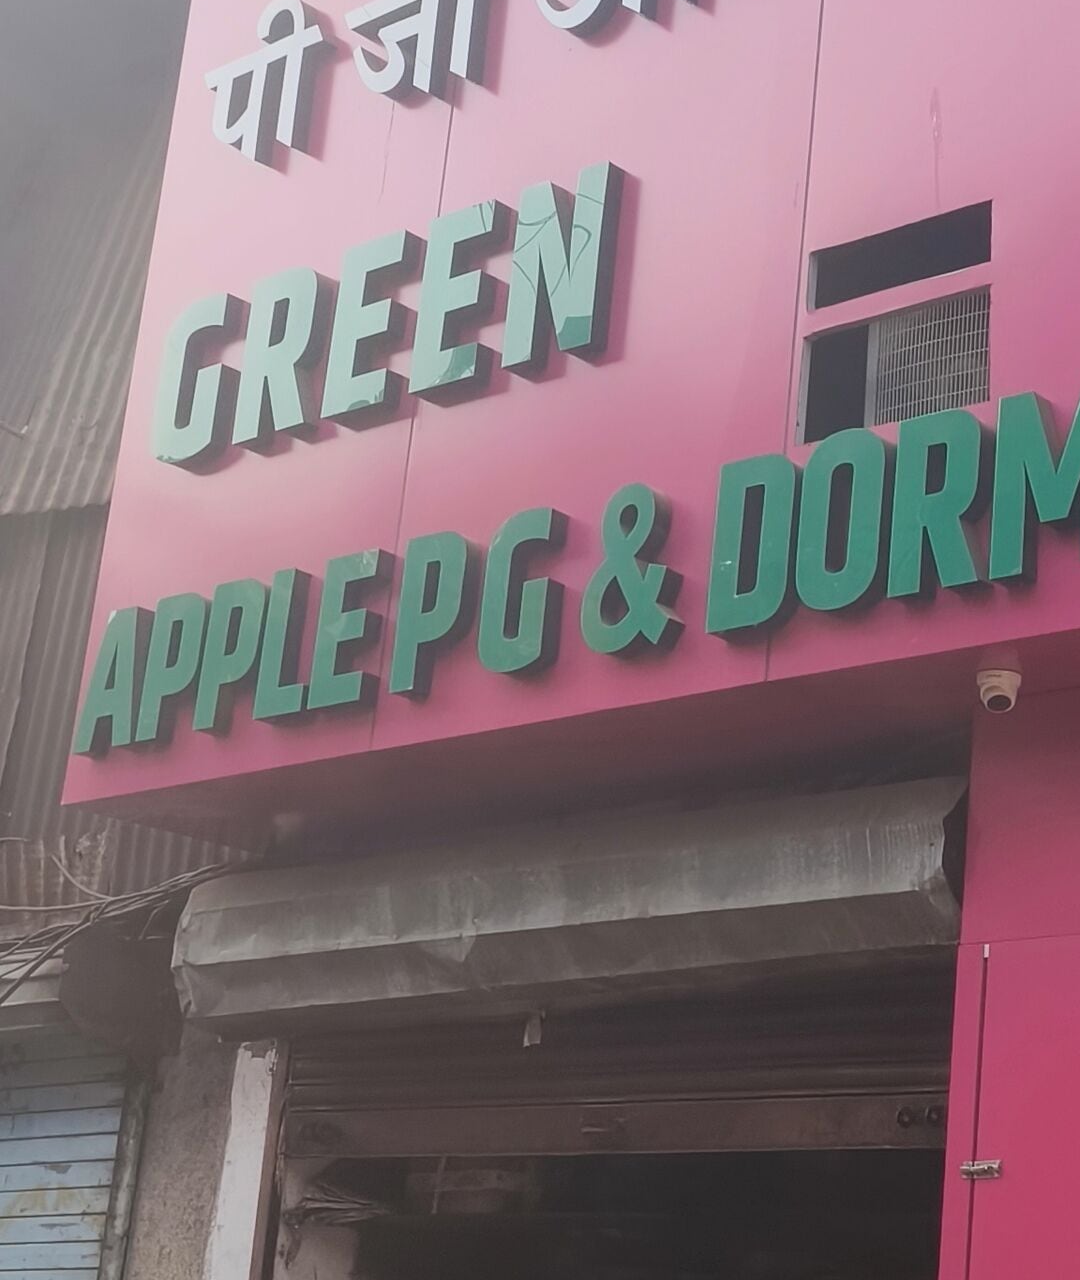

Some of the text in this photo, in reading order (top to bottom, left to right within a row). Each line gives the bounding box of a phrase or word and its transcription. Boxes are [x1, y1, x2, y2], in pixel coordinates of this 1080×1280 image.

[150, 161, 616, 465] GREEN
[73, 547, 384, 756] APPLE
[580, 482, 682, 656] &
